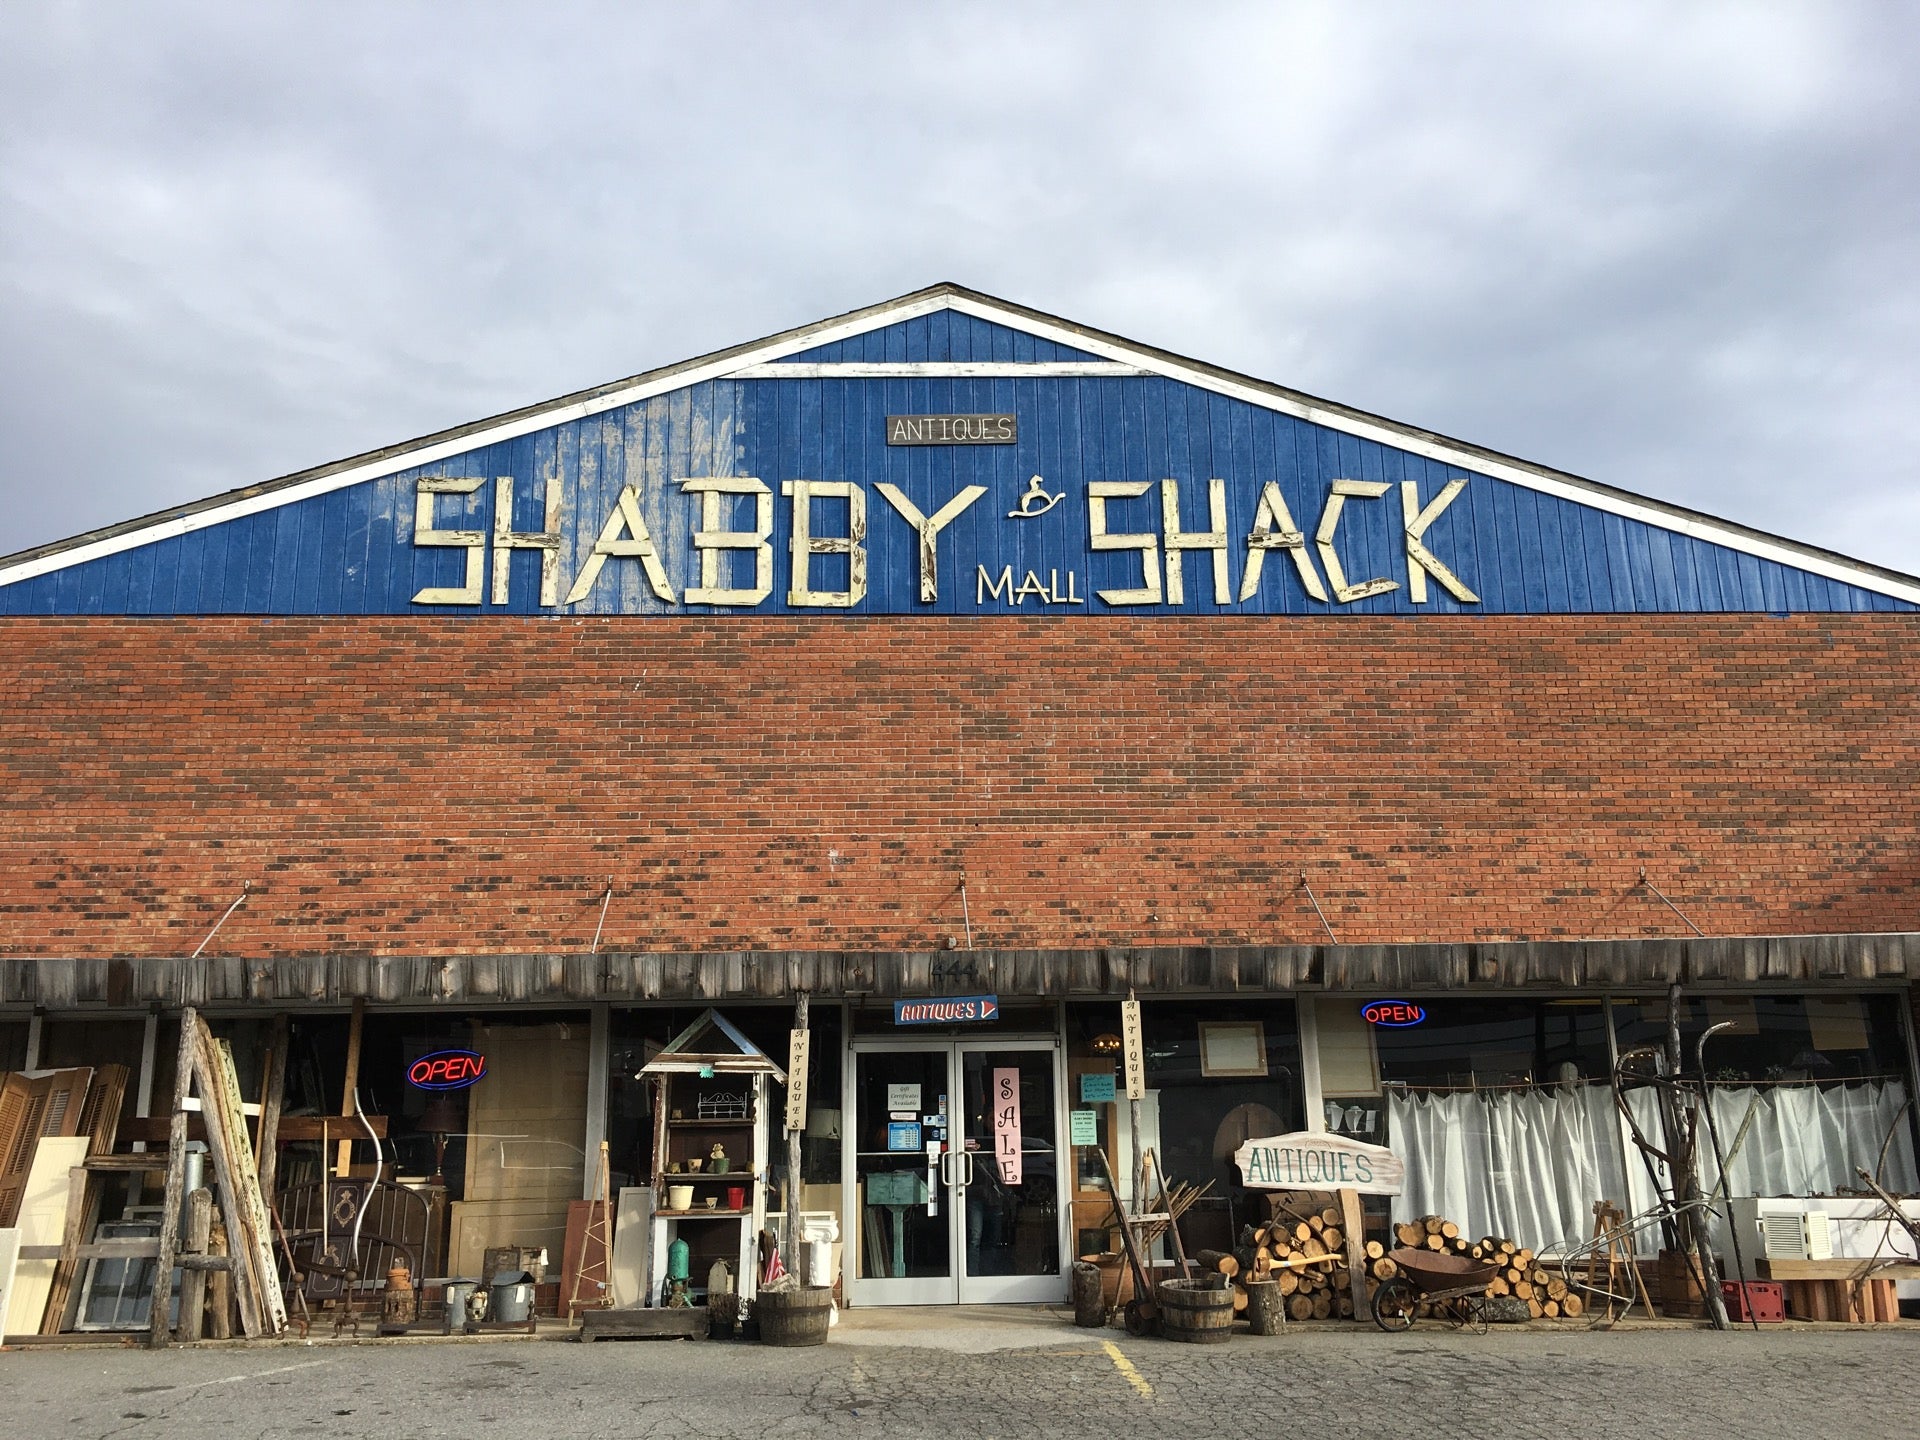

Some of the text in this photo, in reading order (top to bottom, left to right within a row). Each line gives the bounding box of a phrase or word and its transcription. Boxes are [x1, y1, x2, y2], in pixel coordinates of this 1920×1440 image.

[893, 417, 1012, 440] ANTIQUES
[410, 476, 1482, 608] SHABBY SHACK
[977, 563, 1084, 606] MALL
[931, 959, 979, 983] 444
[900, 1001, 976, 1021] ANTIQUES
[1365, 1005, 1419, 1023] OPEN
[1126, 1001, 1139, 1098] ANTIQUES
[410, 1055, 485, 1083] OPEN
[792, 1030, 804, 1128] ANTIQUES
[997, 1078, 1018, 1183] SALE
[1246, 1147, 1373, 1183] ANTIQUES
